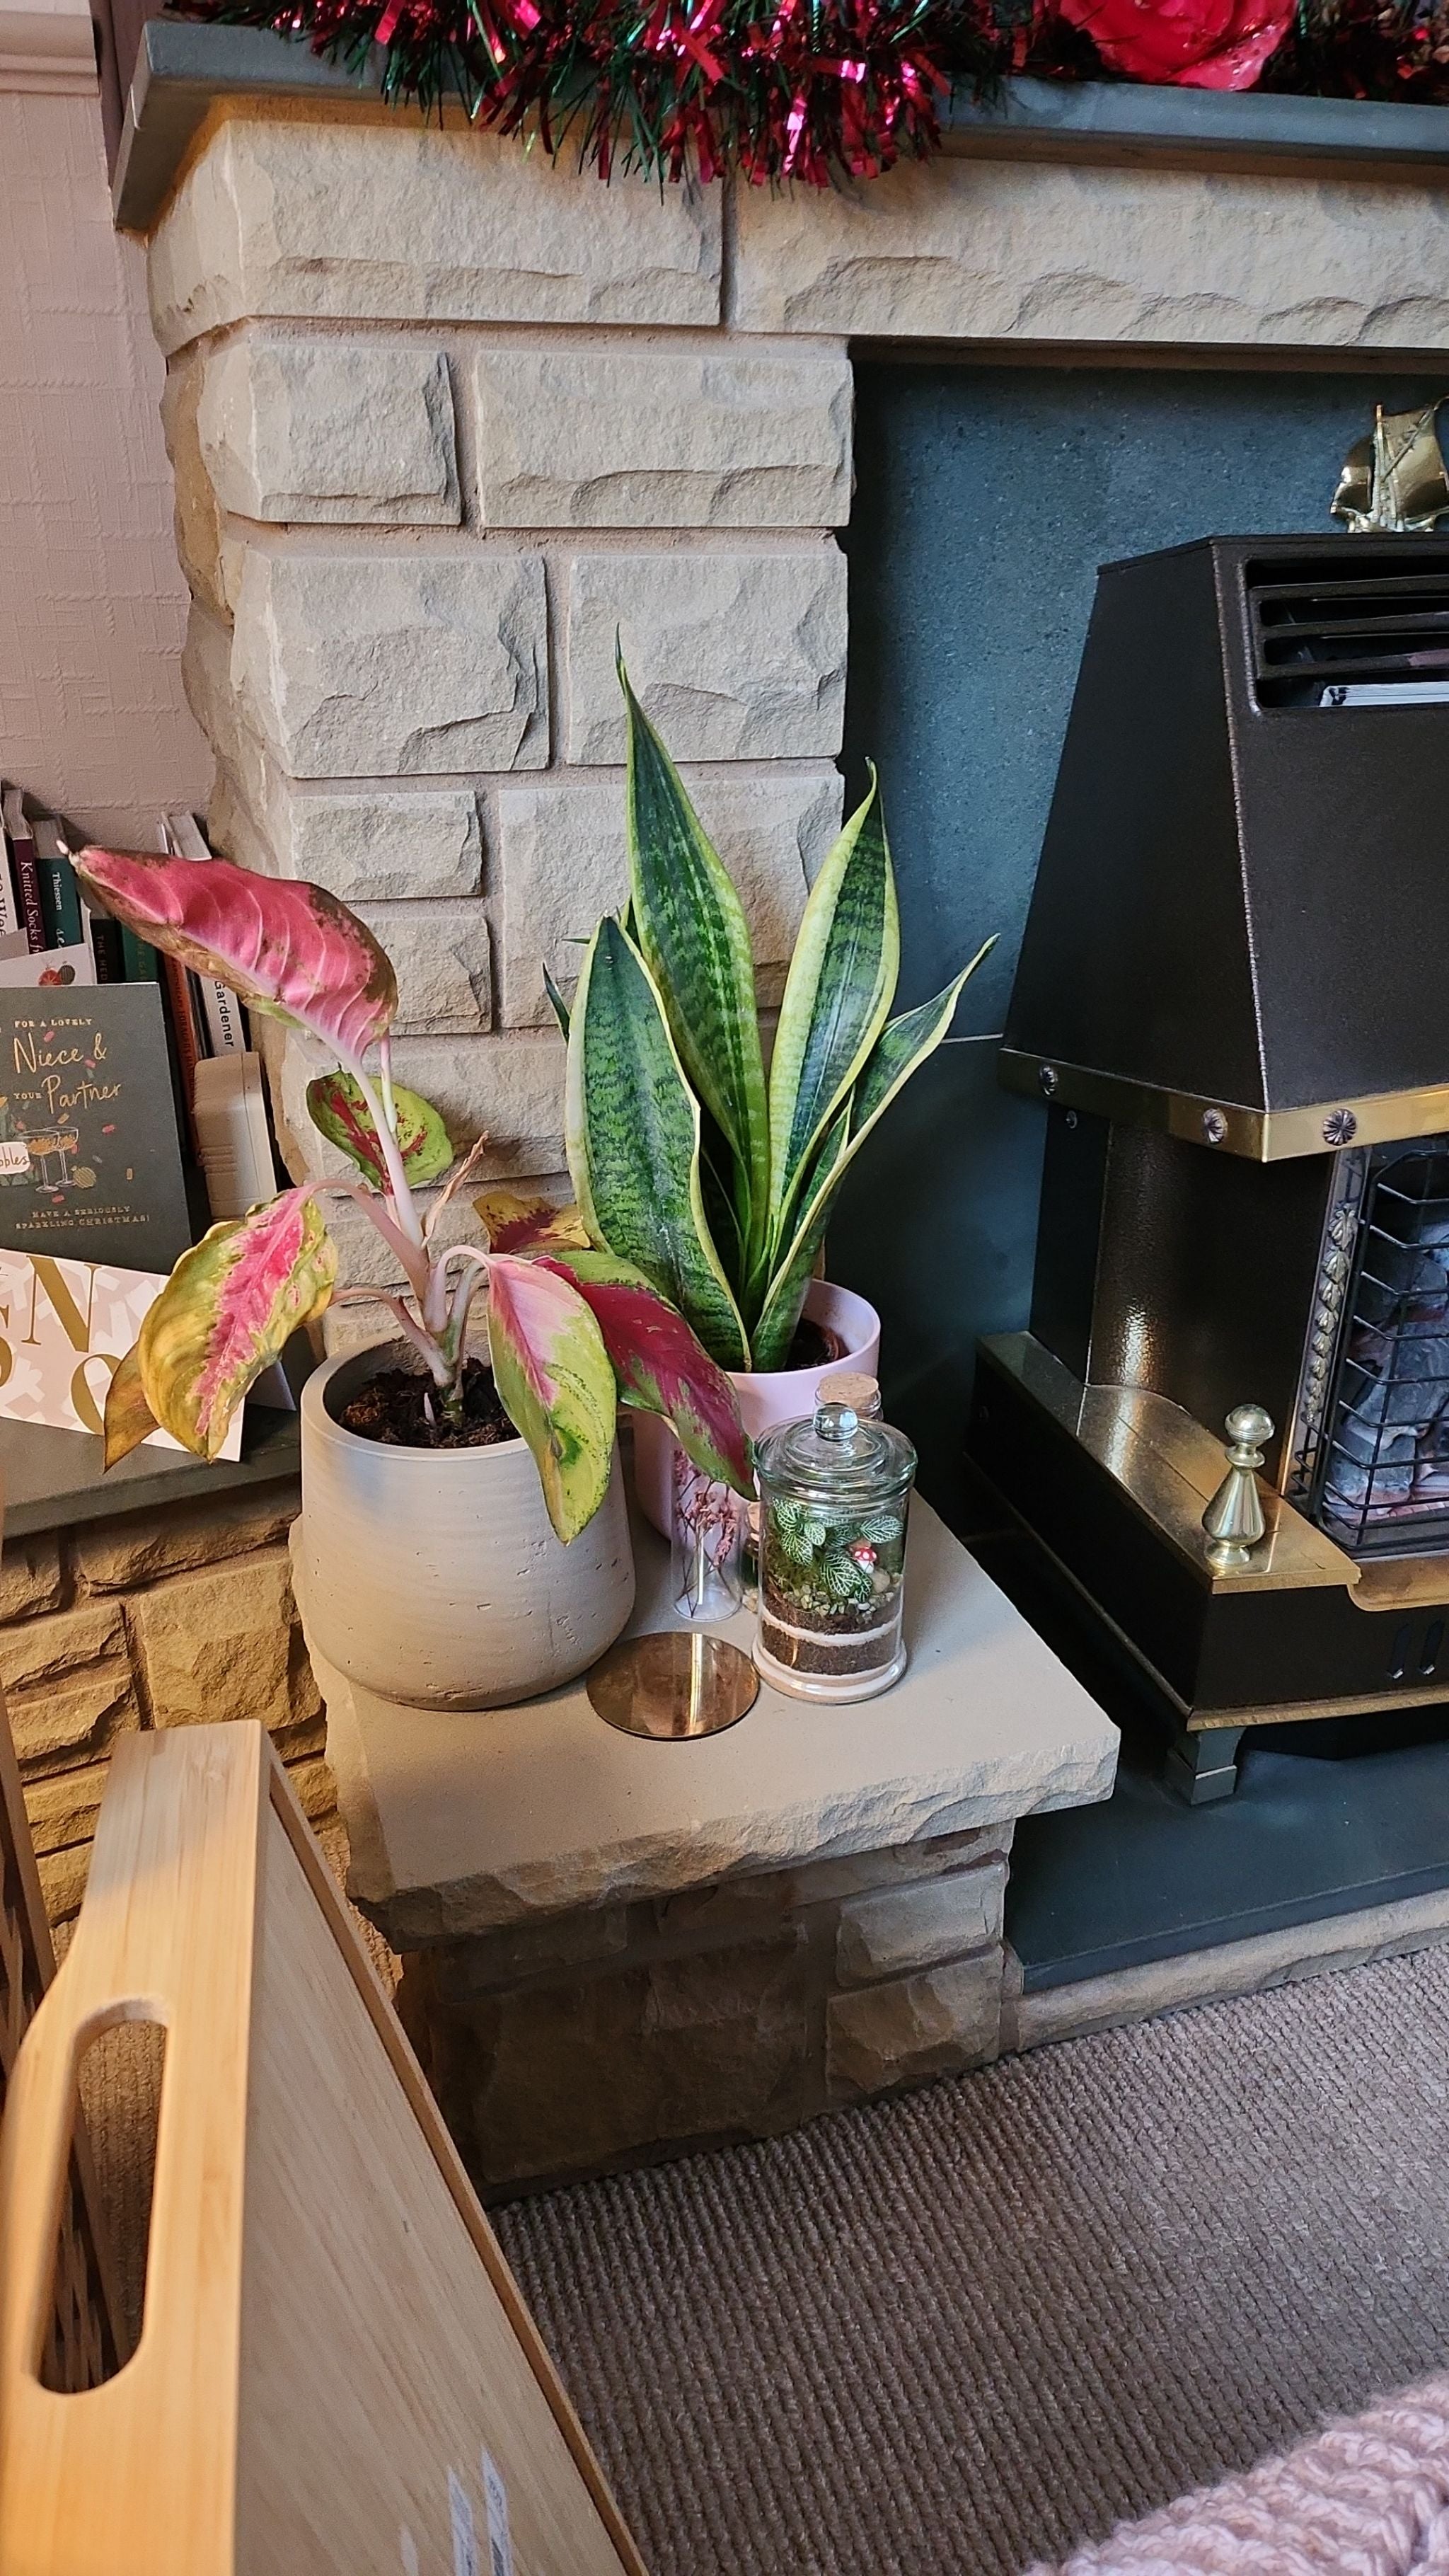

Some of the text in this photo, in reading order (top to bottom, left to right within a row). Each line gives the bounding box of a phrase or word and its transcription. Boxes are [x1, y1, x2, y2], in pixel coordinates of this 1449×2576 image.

[21, 861, 38, 905] Knitted
[52, 871, 62, 911] Thiessen
[27, 909, 42, 941] Socks
[51, 1018, 93, 1027] LOVELY
[214, 980, 235, 1047] Gardener
[13, 1032, 108, 1074] Niece &
[41, 1074, 122, 1115] Partner
[16, 1214, 151, 1230] SPARKLING CHRISTMAS!
[74, 1205, 131, 1216] SERIOUSLY
